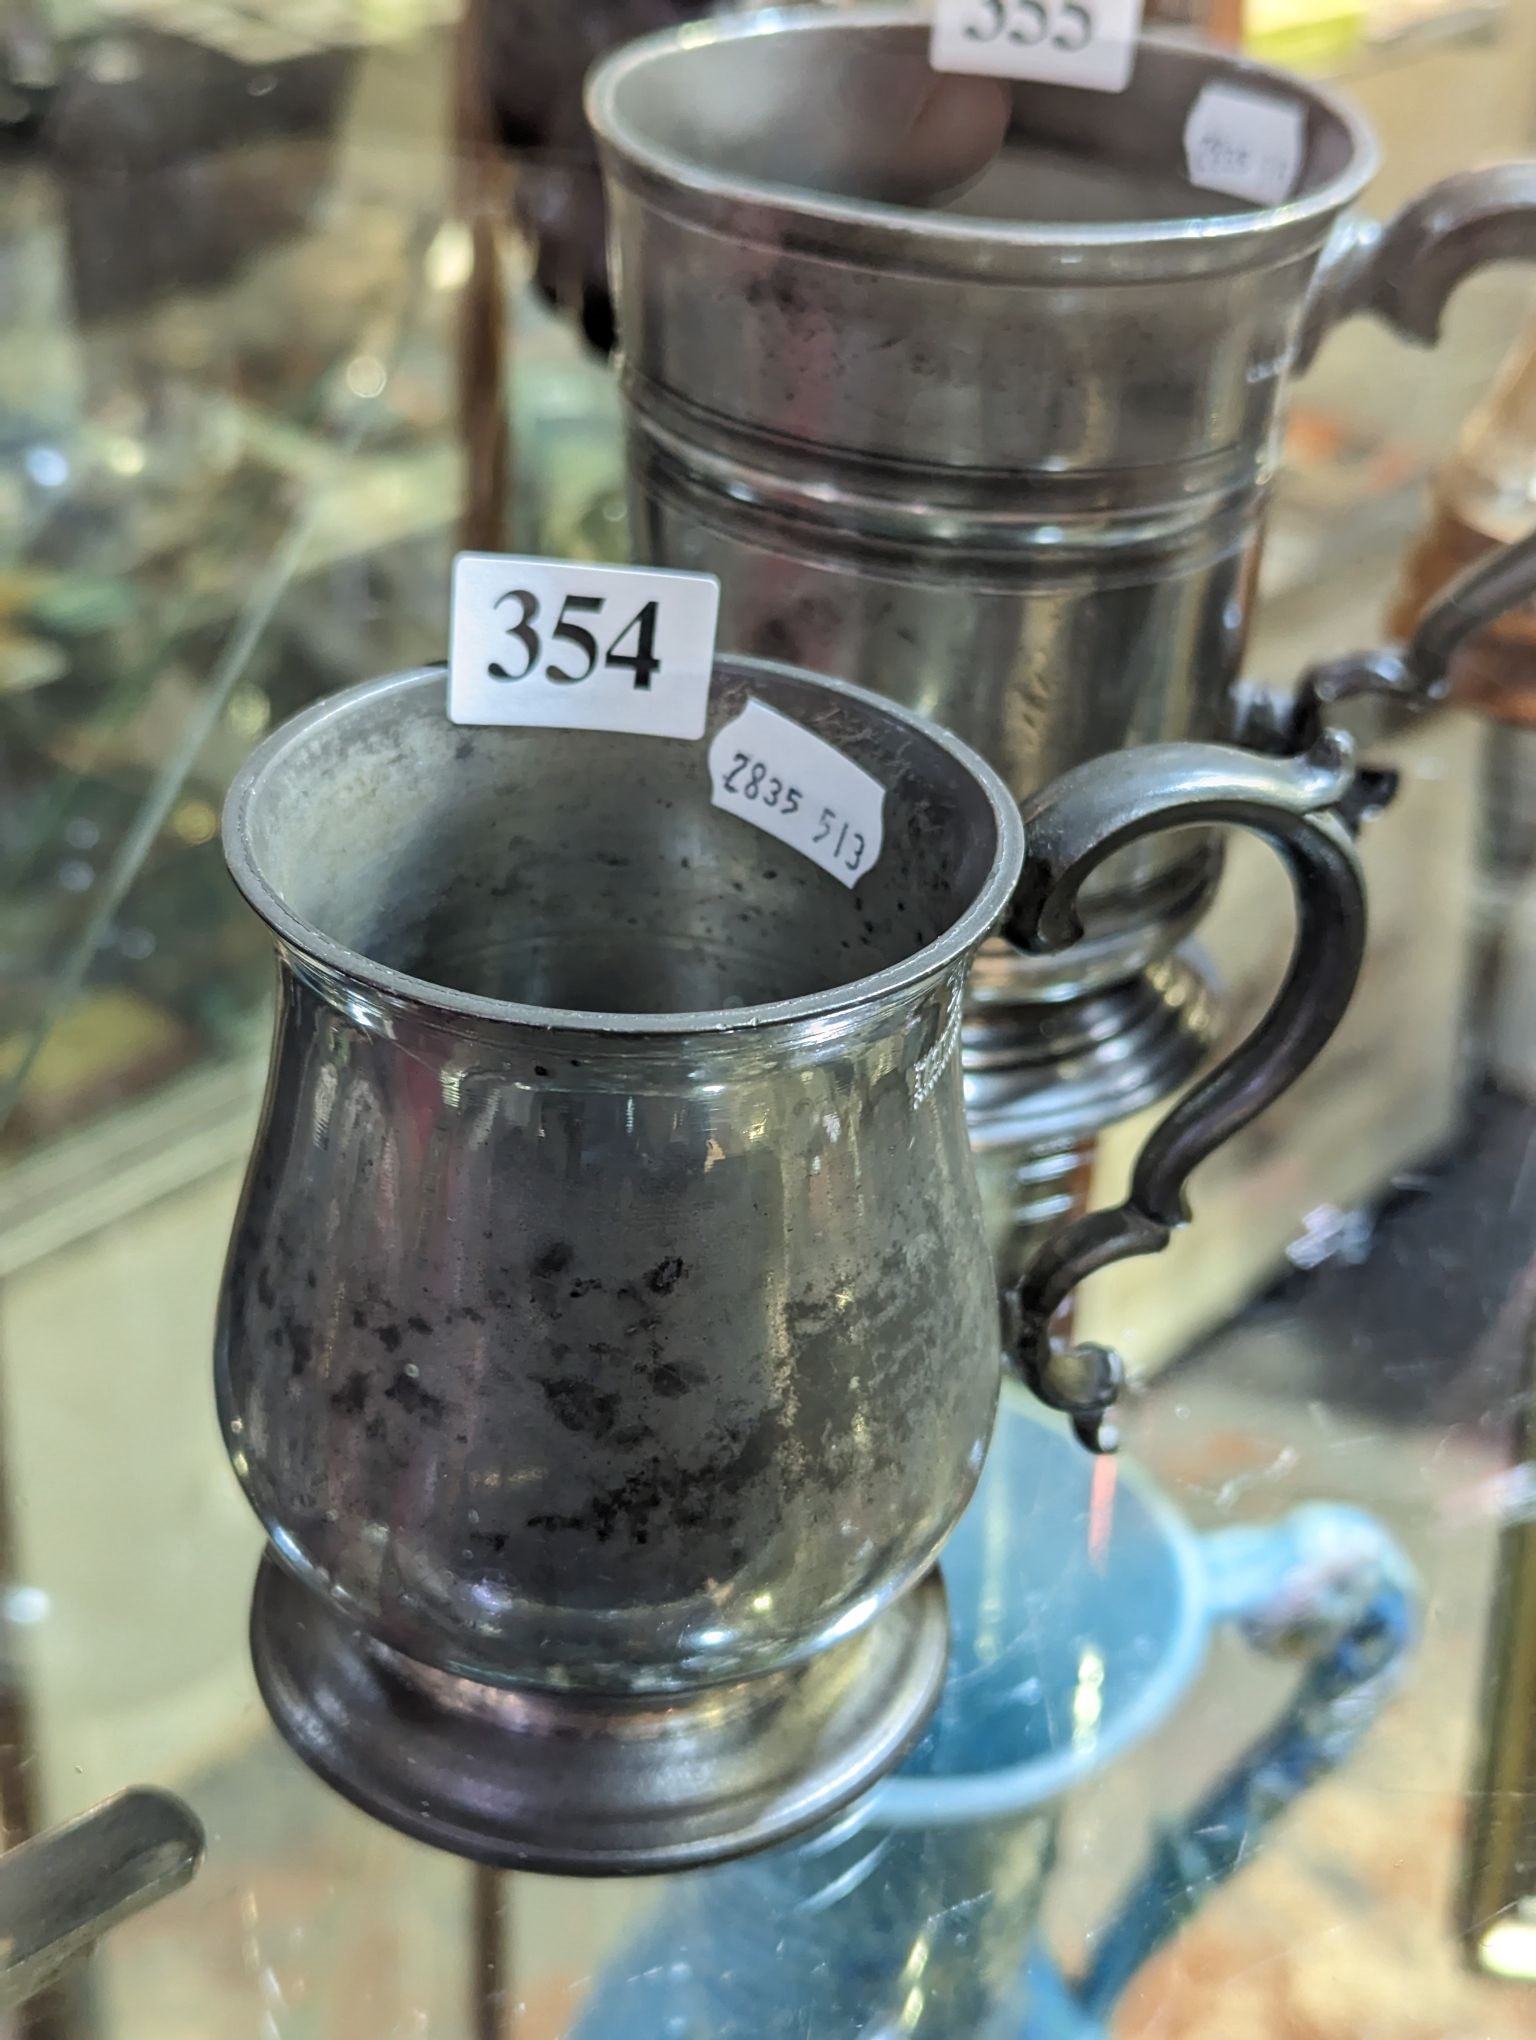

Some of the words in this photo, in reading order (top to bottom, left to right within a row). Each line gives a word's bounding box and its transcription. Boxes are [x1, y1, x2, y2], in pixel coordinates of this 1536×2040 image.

[488, 588, 662, 691] 354
[722, 752, 803, 814] 2835
[812, 807, 866, 871] 513
